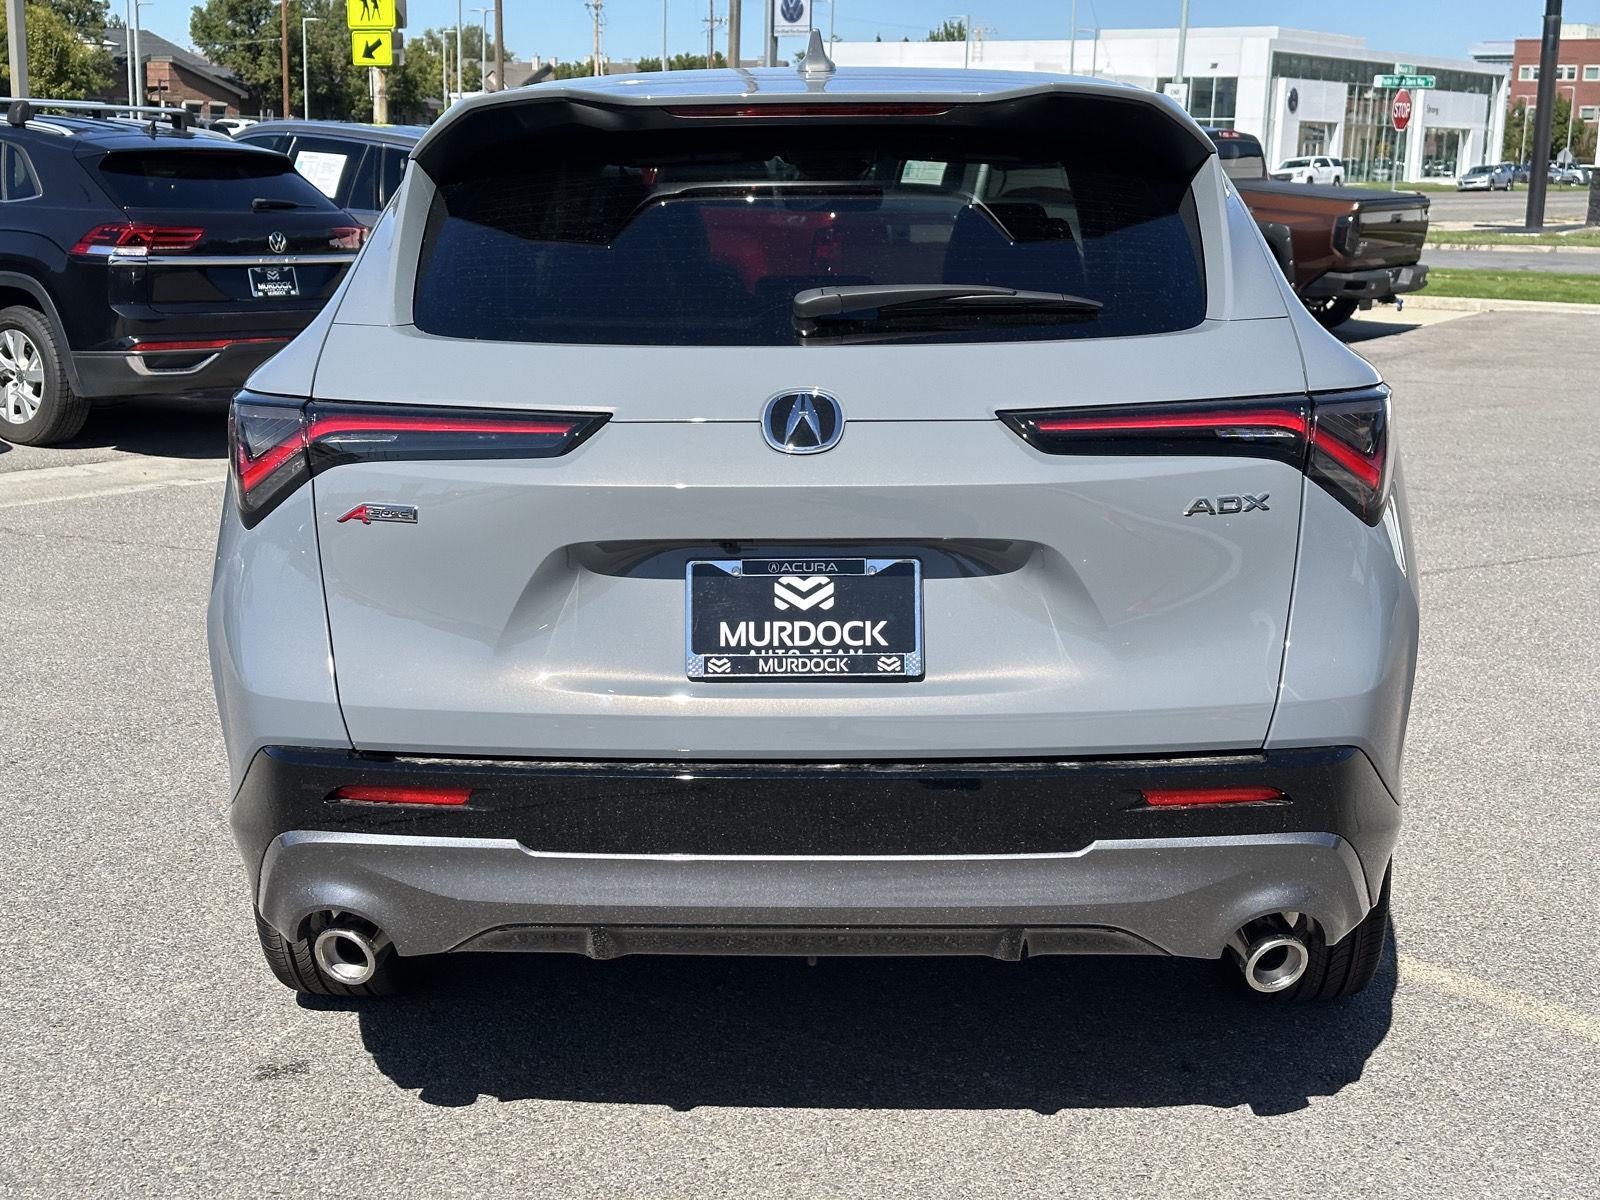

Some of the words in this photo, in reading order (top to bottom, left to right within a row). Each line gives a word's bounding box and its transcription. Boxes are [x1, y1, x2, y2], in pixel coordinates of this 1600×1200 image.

[1393, 102, 1410, 118] STOP
[257, 281, 292, 290] MURDOCK
[1183, 491, 1270, 517] ADX
[780, 562, 838, 572] ACURA
[719, 620, 889, 647] MURDOCK
[758, 658, 849, 673] MURDOCK
